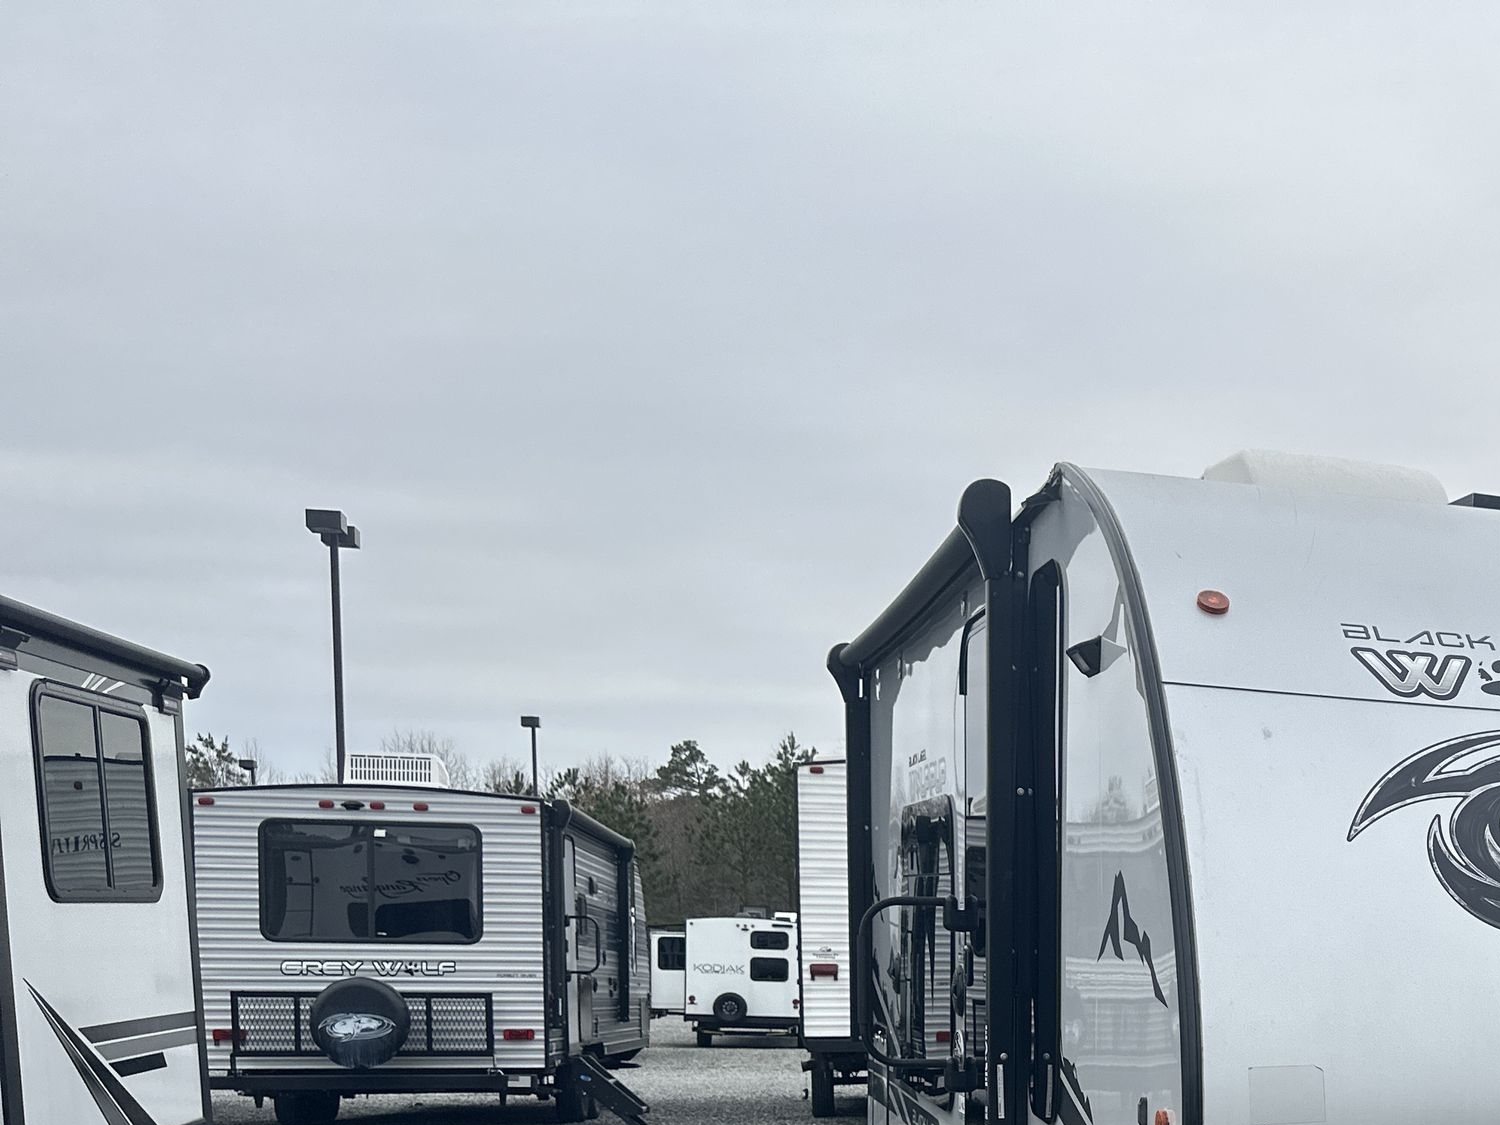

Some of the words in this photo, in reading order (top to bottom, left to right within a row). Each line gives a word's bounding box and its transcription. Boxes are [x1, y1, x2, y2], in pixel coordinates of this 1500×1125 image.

[1341, 622, 1496, 651] BLACK
[280, 960, 363, 977] GREY
[693, 963, 745, 974] KODIAK
